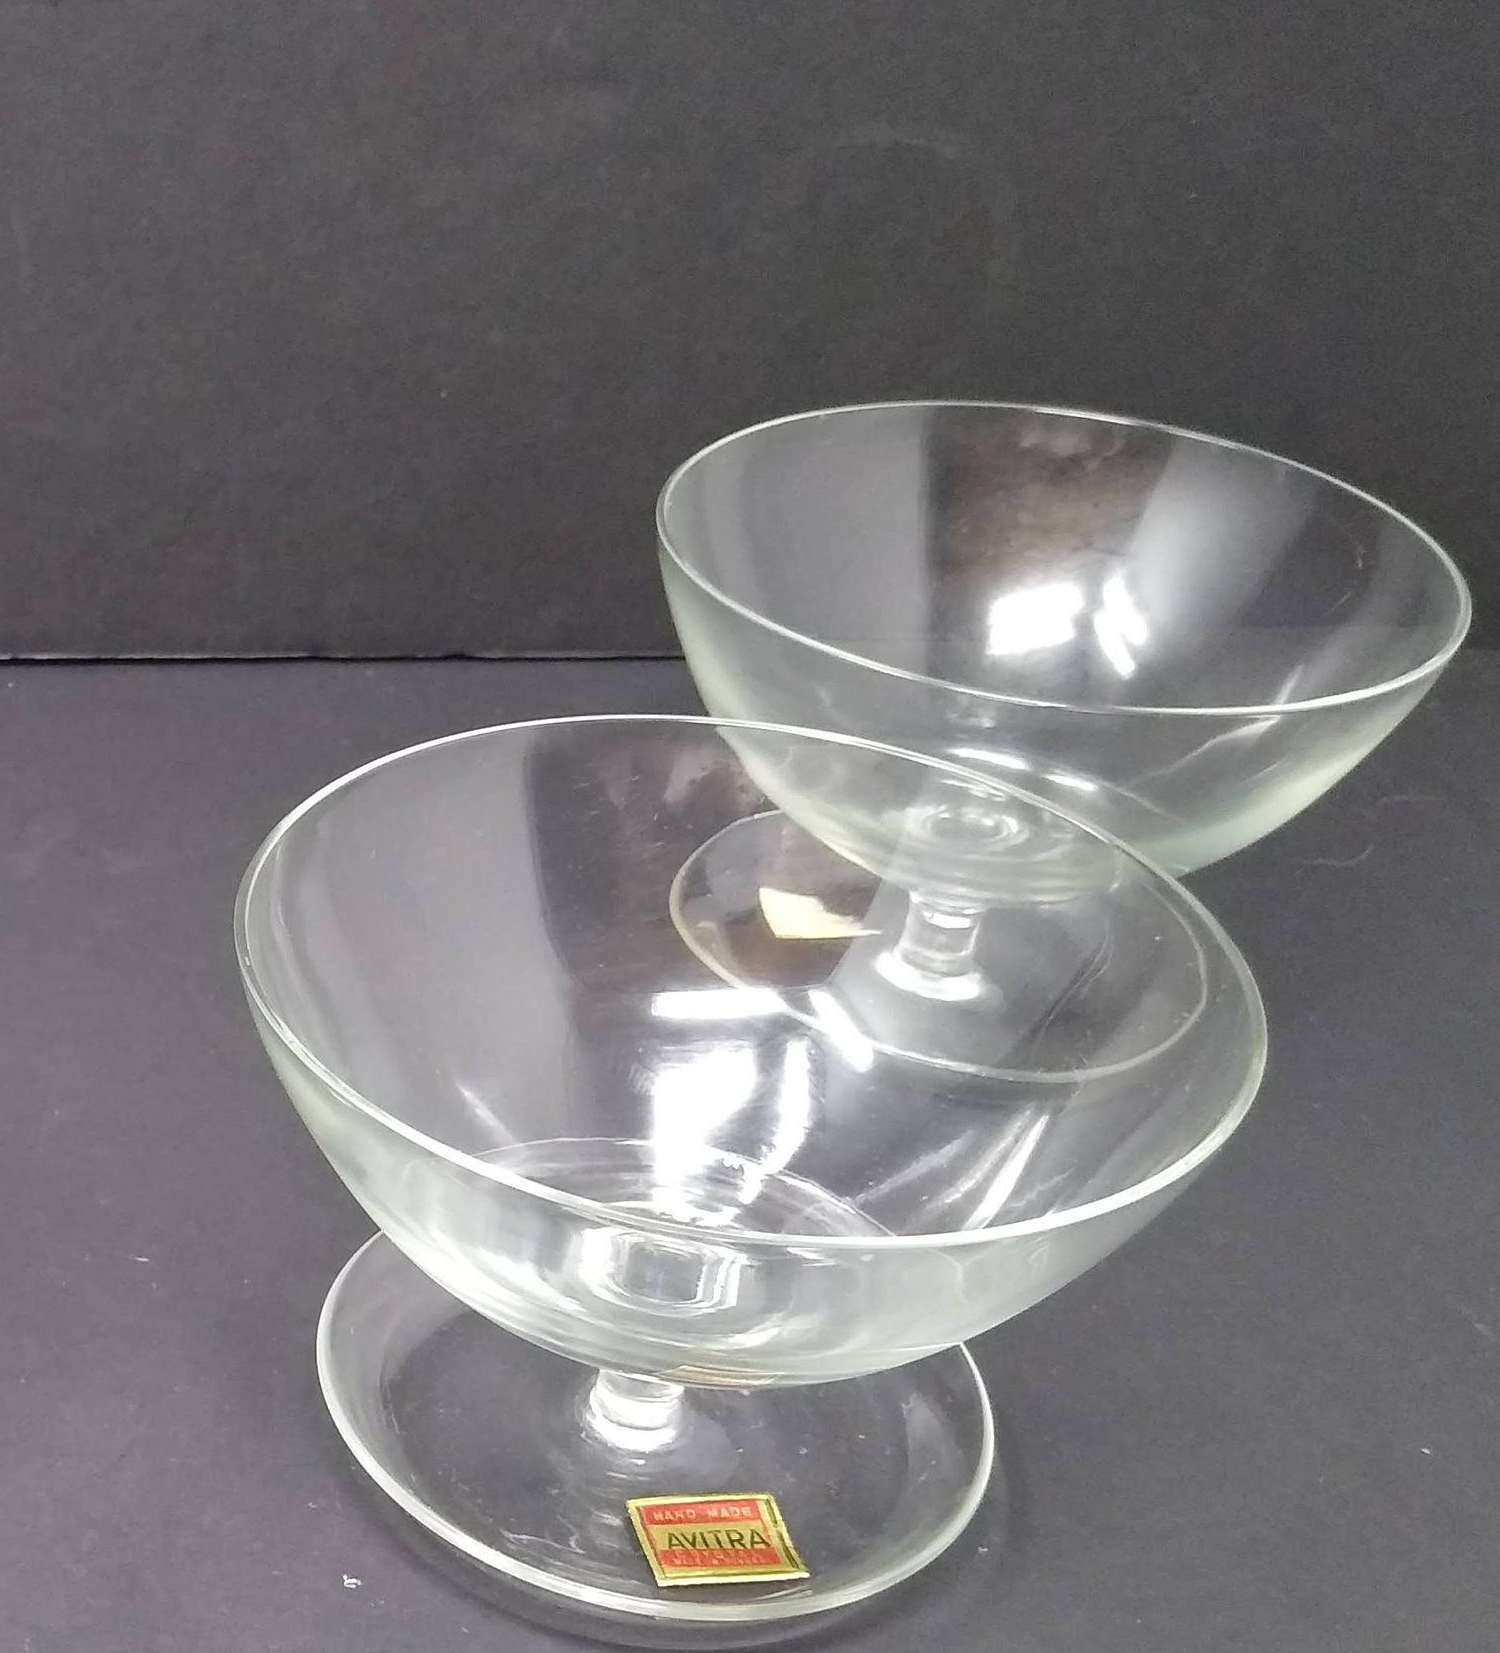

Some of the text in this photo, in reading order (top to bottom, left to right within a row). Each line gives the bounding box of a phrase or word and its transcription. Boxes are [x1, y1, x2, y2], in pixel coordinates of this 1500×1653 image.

[652, 1505, 753, 1521] HAND MADE
[668, 1528, 771, 1550] AVITRA
